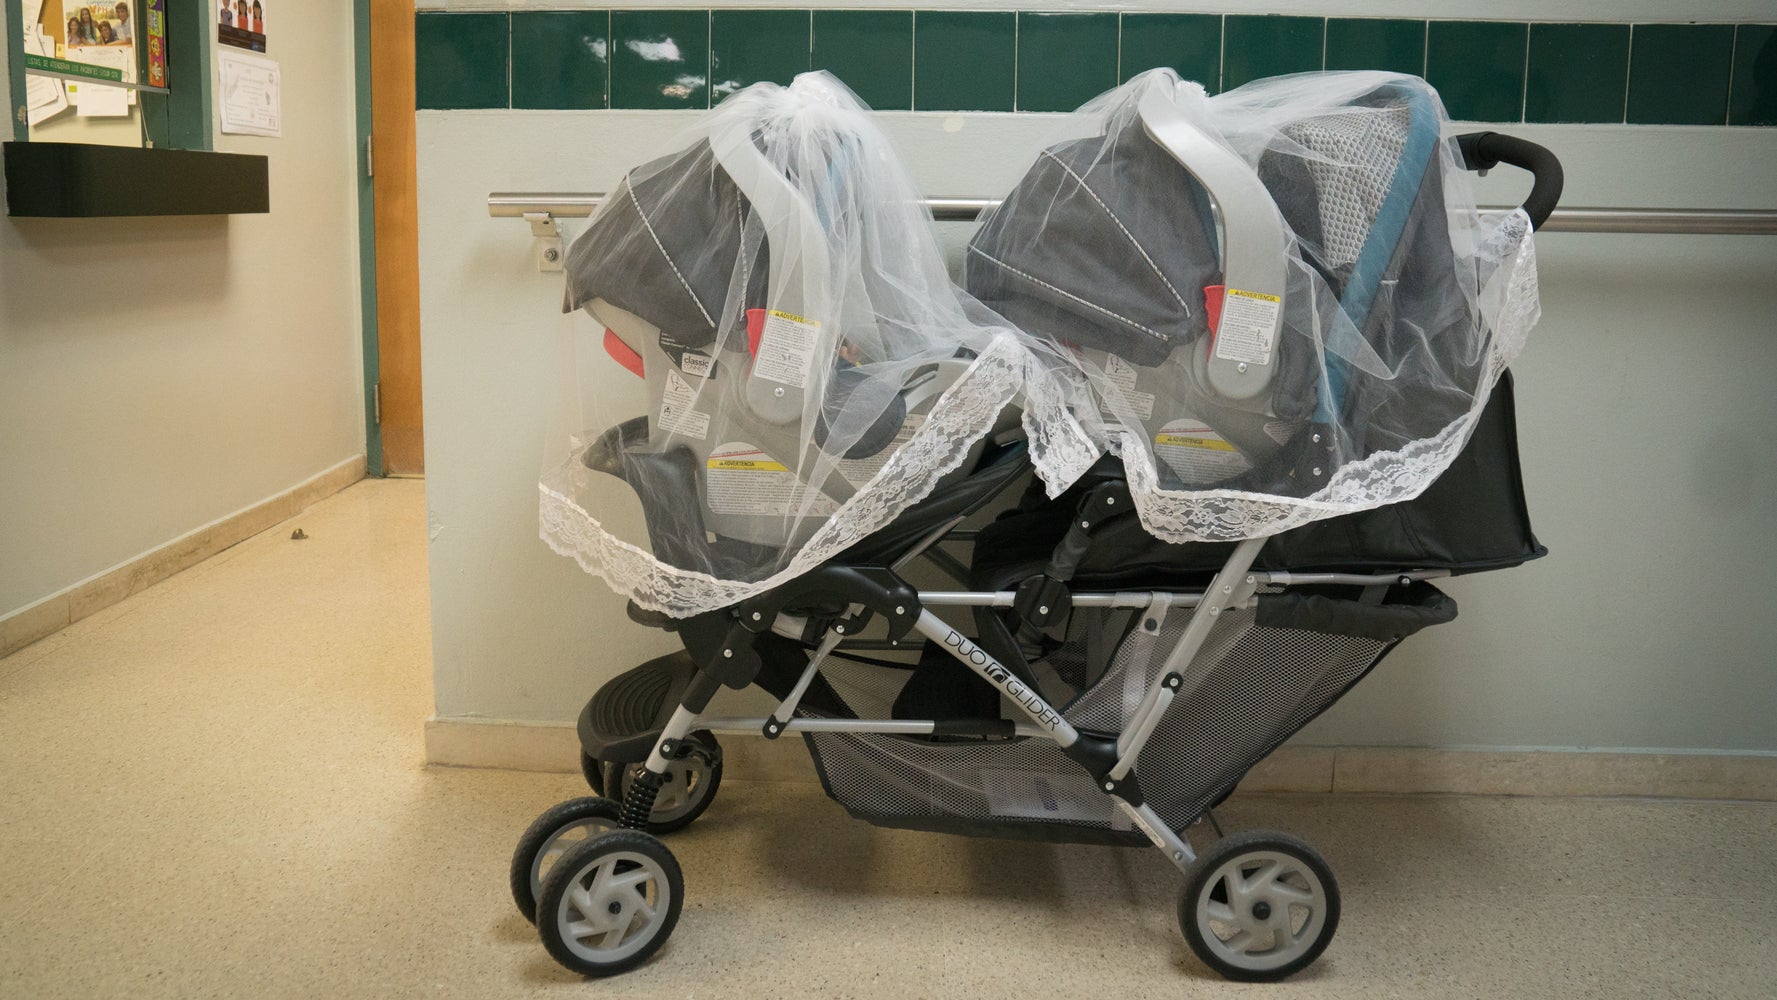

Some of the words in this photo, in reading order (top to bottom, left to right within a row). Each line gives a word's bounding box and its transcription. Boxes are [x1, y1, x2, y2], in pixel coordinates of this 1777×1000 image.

[1240, 290, 1275, 302] ADVERTENCIA
[684, 356, 709, 367] classic
[944, 630, 986, 665] DUO
[1006, 680, 1060, 731] GLIDER
